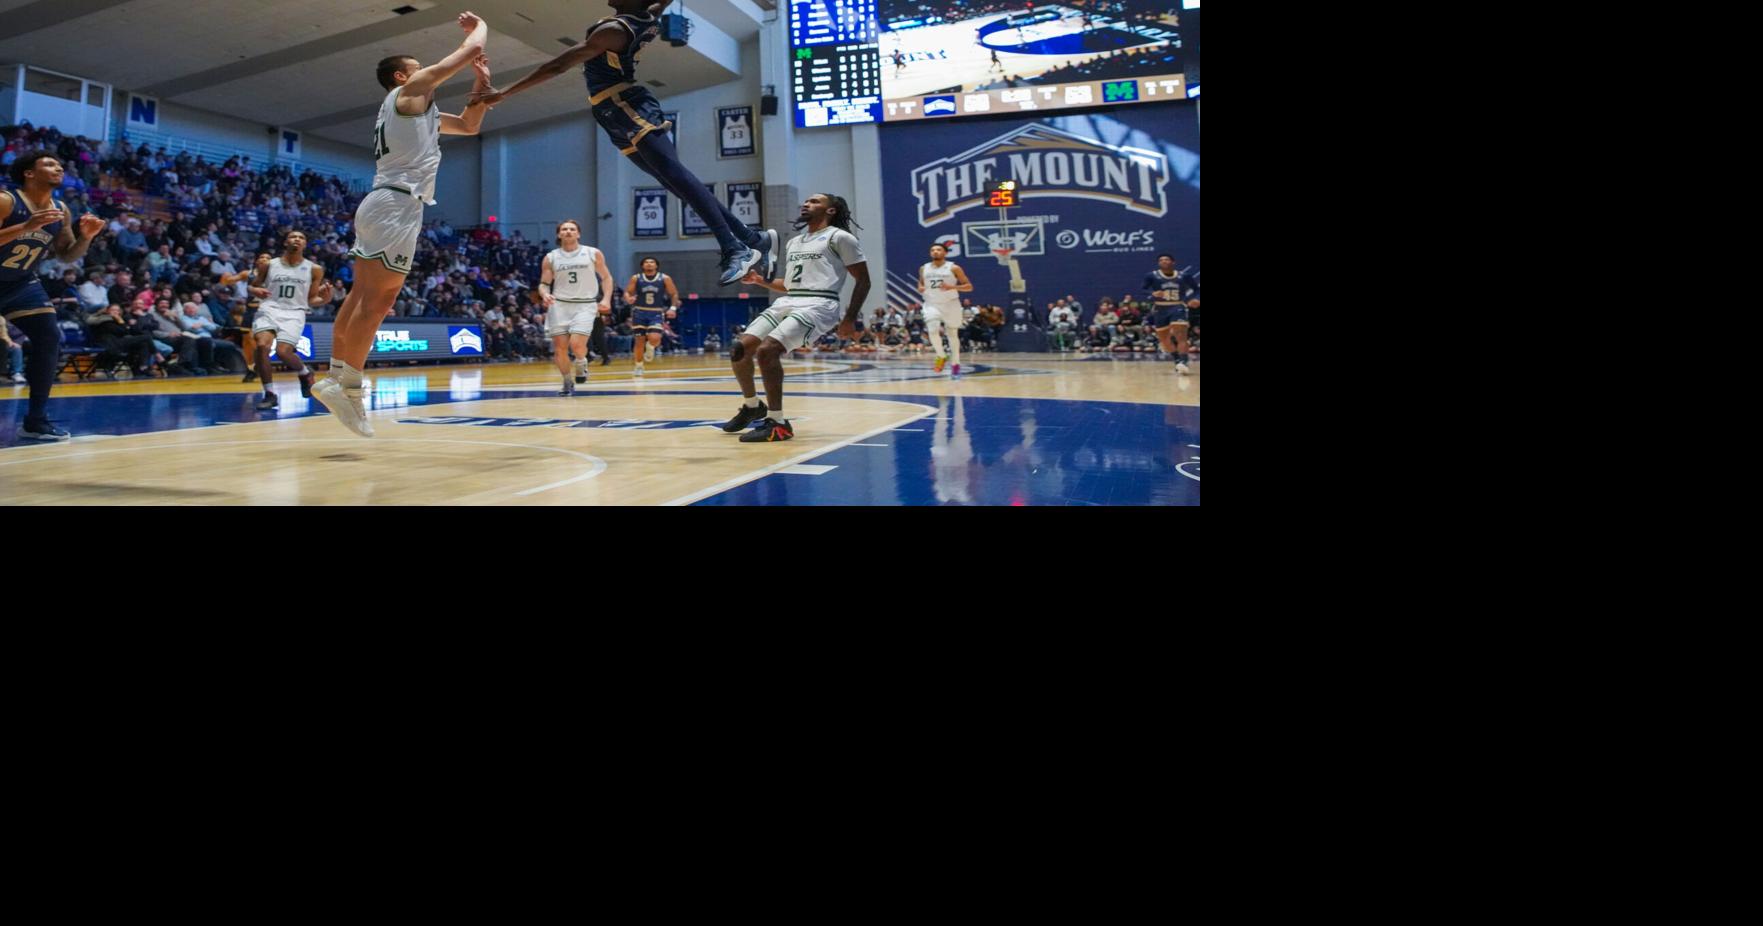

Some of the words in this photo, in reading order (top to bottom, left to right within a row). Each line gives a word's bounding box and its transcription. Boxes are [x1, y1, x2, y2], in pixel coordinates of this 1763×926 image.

[1104, 81, 1134, 101] M
[130, 96, 156, 126] N
[282, 130, 299, 154] T
[729, 130, 744, 140] 33
[1008, 151, 1159, 203] MOUNT
[990, 190, 1014, 206] 25
[643, 211, 657, 220] 50
[739, 207, 751, 216] 51
[1083, 229, 1154, 246] WOLF'S
[1, 244, 43, 271] 21
[567, 271, 578, 284] 3
[791, 263, 804, 283] 2
[278, 284, 296, 299] 10
[645, 292, 655, 305] 5
[376, 330, 410, 342] TRUE
[376, 340, 428, 352] SPORTS
